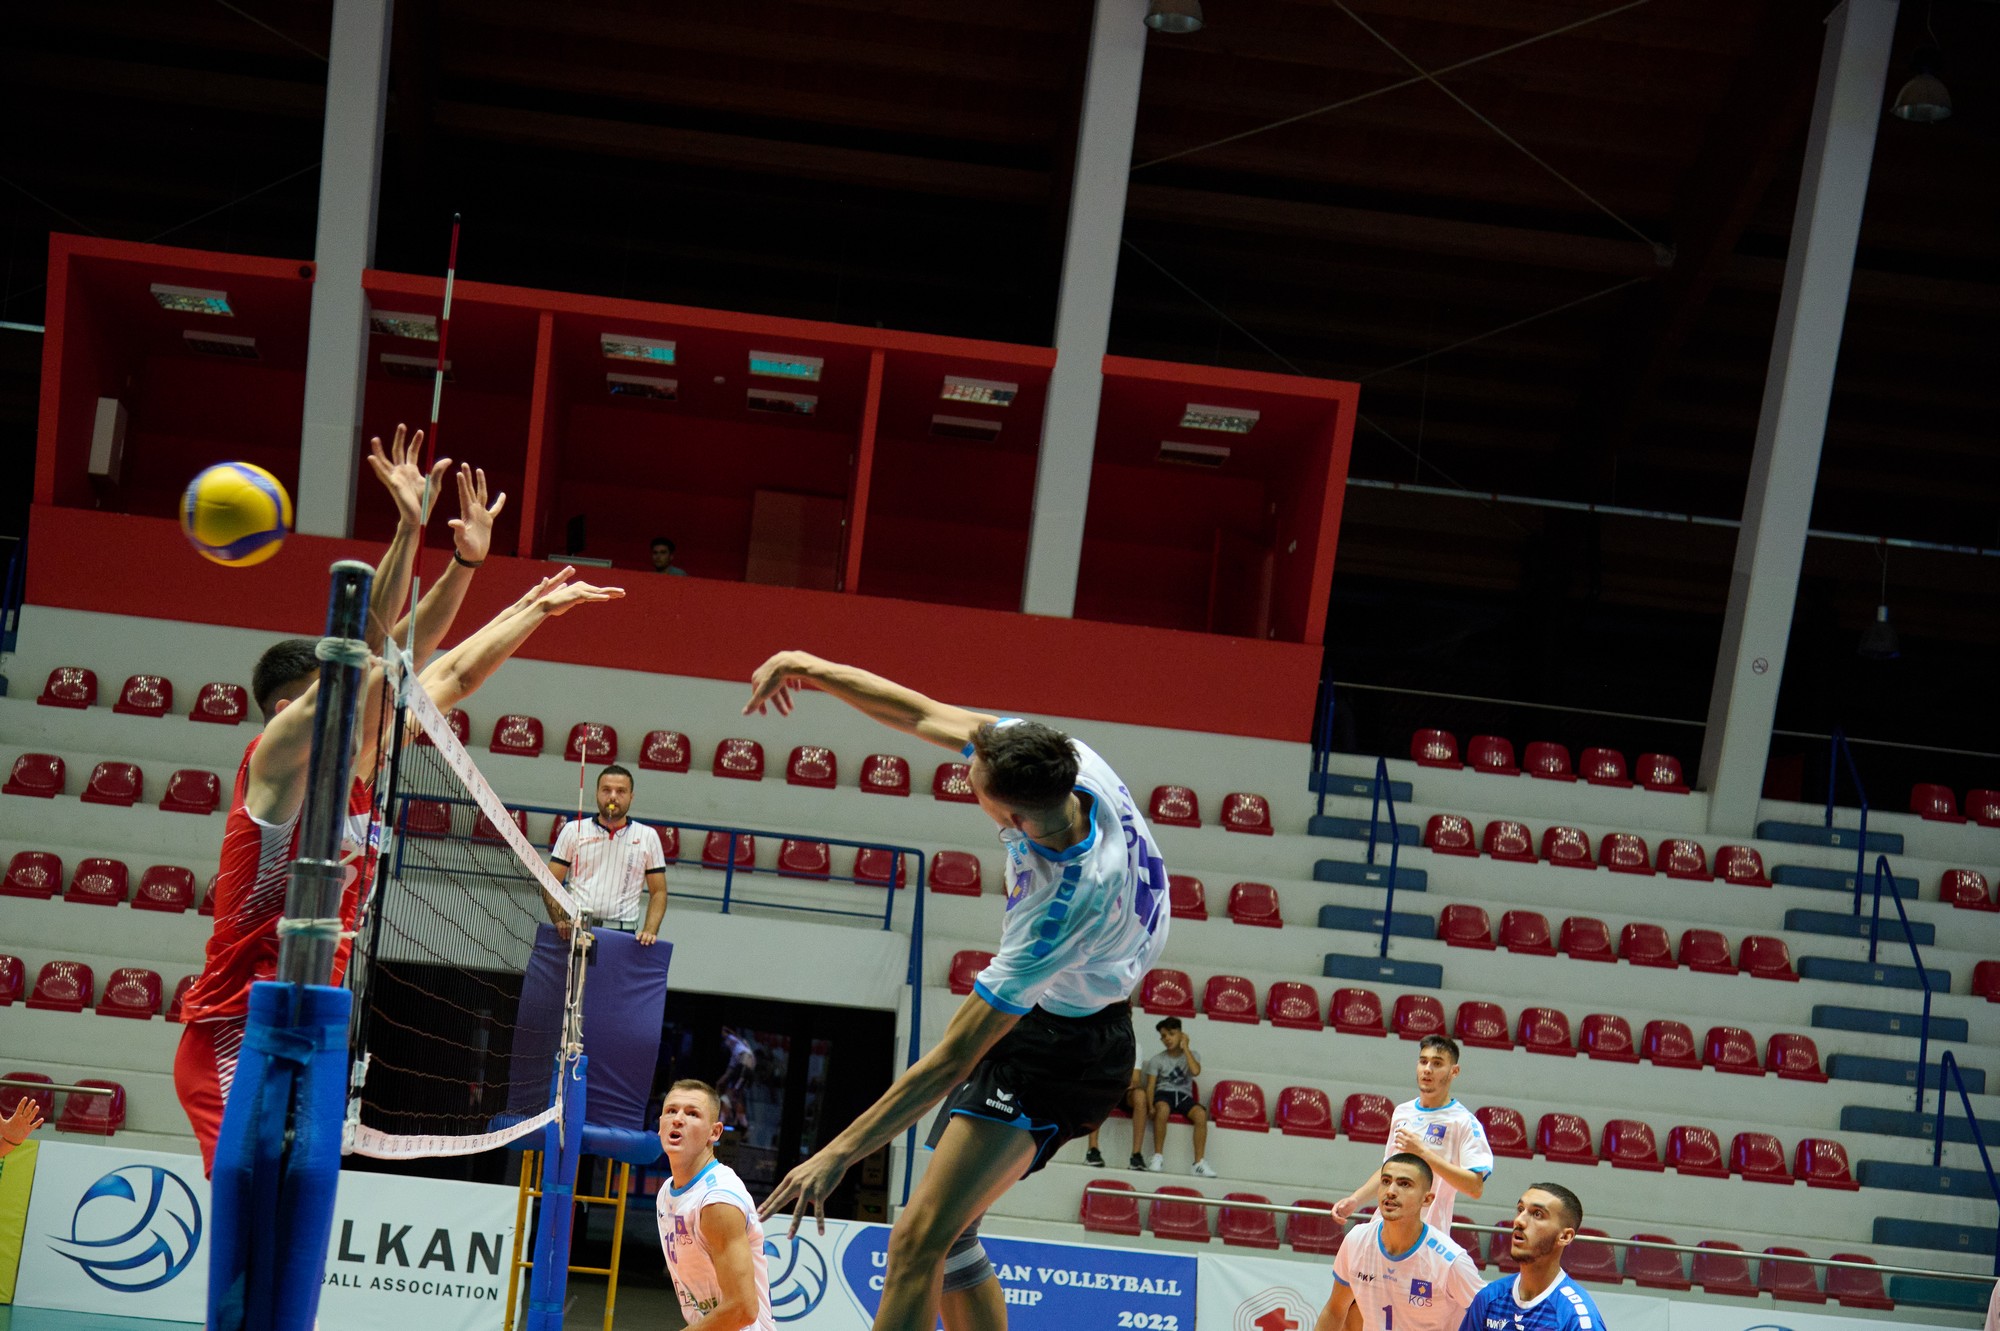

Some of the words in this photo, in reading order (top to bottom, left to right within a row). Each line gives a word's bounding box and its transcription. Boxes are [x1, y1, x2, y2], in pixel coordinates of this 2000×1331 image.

[986, 1098, 1014, 1114] erima
[337, 1219, 504, 1275] LKAN
[369, 1277, 499, 1301] ASSOCIATION
[1037, 1267, 1182, 1296] VOLLEYBALL
[1001, 1288, 1043, 1306] HIP
[1408, 1295, 1433, 1308] KOS
[1117, 1311, 1179, 1331] 2022
